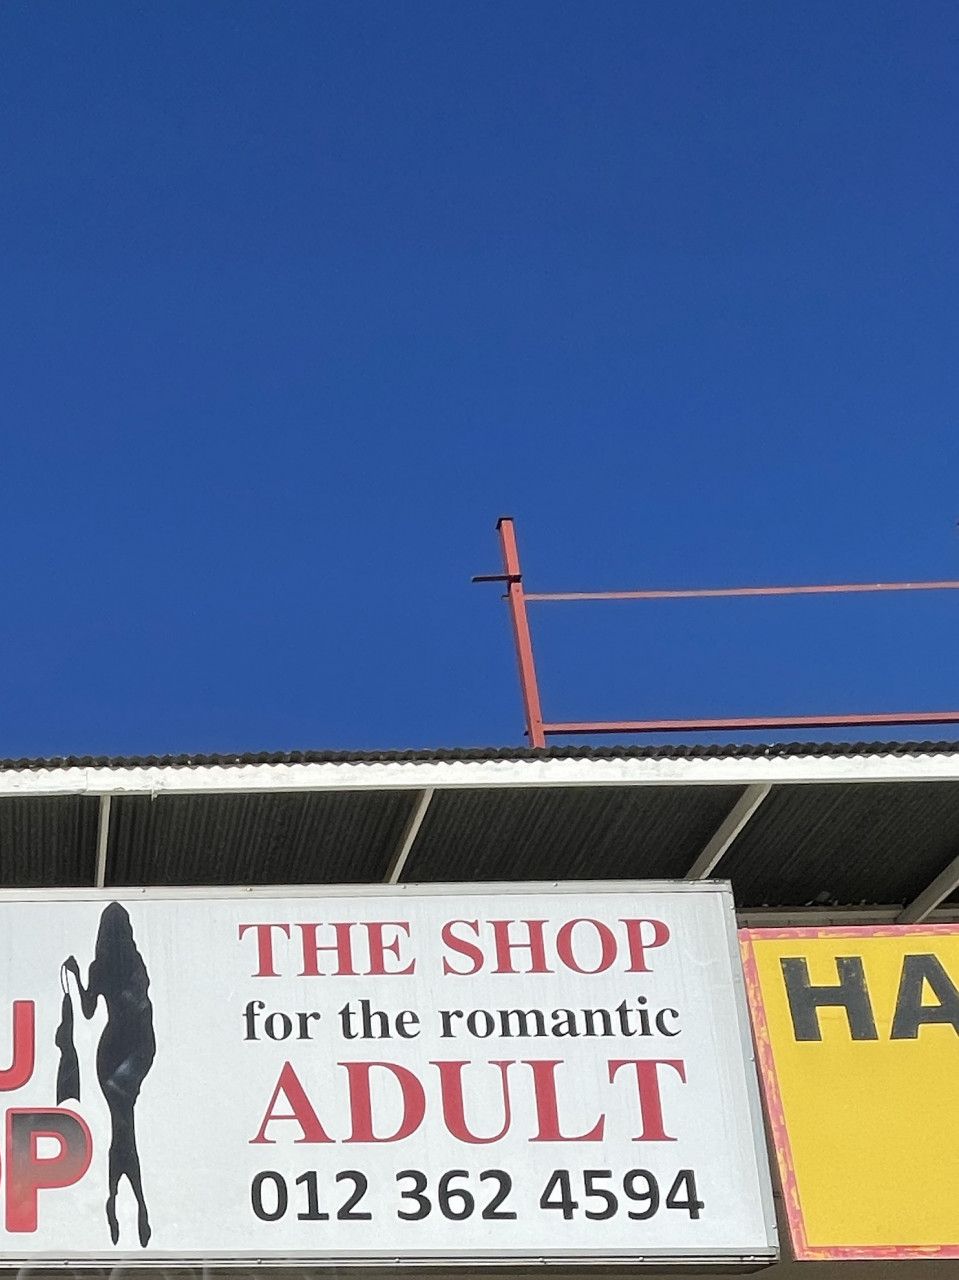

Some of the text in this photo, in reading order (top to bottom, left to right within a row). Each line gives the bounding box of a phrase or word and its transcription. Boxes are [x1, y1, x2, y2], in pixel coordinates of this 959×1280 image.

[239, 917, 671, 977] THE SHOP
[242, 995, 683, 1041] for the romantic
[248, 1059, 687, 1145] ADULT
[251, 1168, 705, 1221] 012 362 4594
